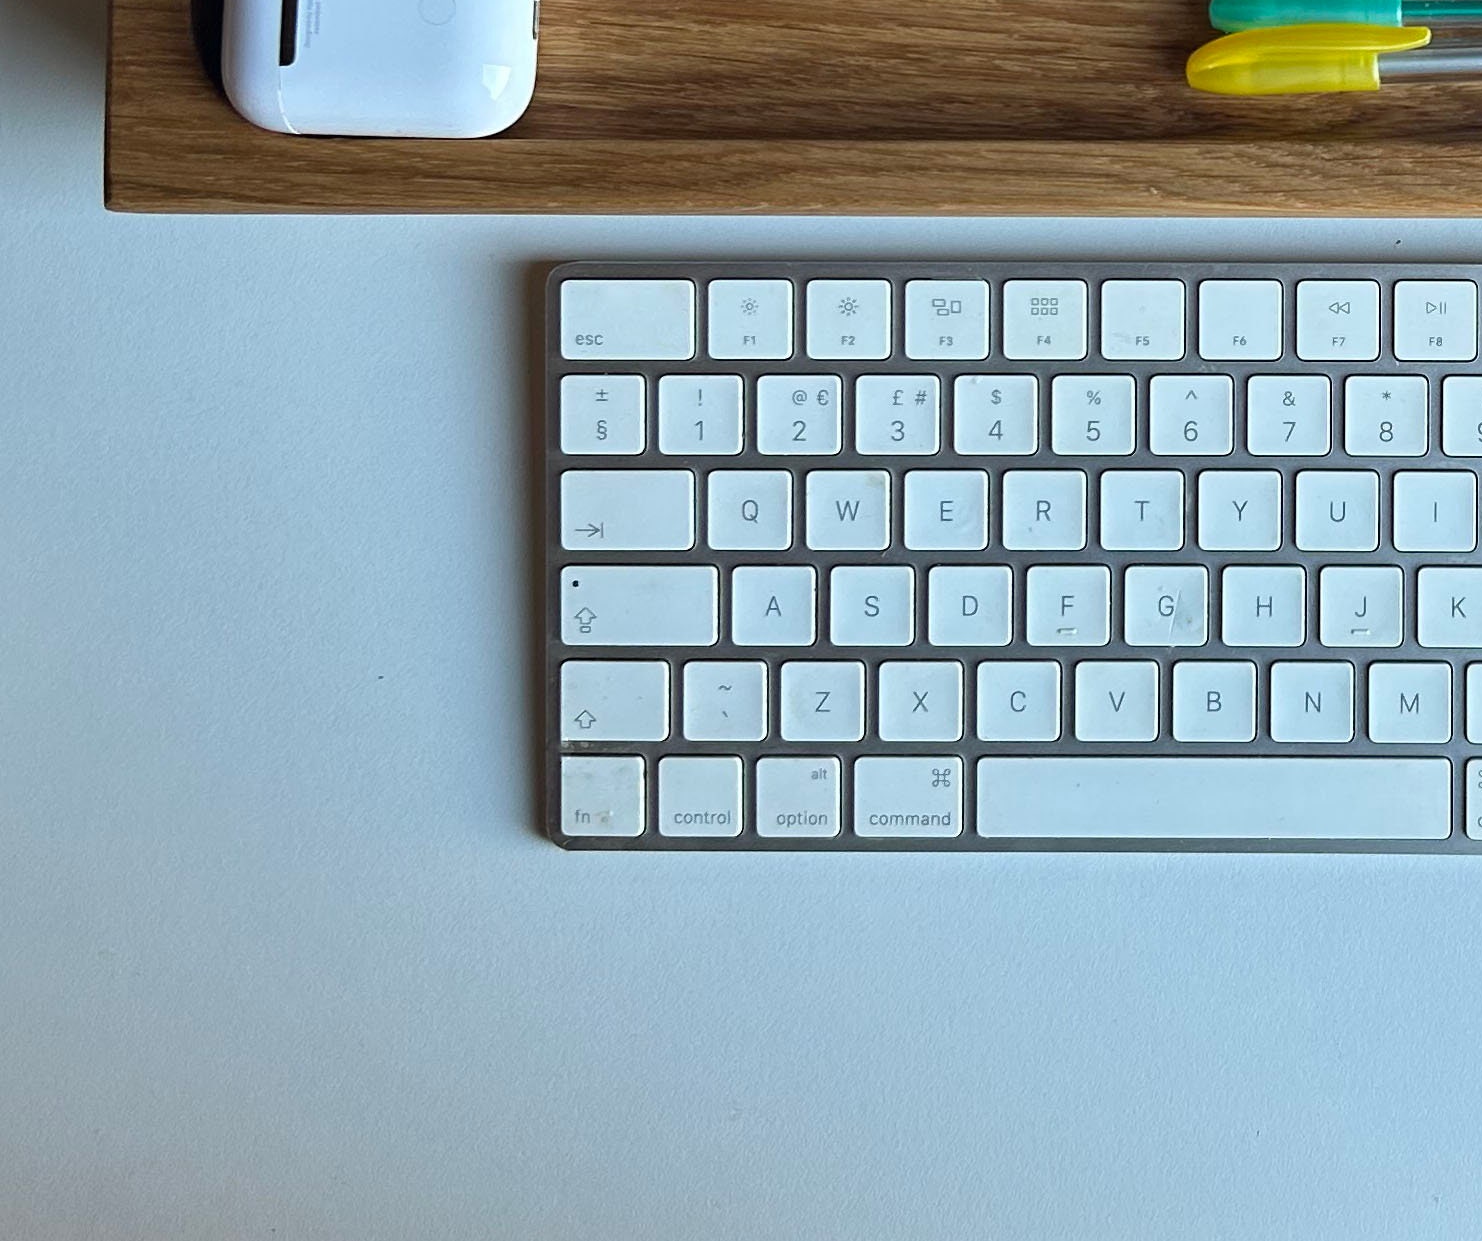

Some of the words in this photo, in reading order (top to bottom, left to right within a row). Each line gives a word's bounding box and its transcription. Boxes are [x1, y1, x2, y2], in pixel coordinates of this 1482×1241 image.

[574, 334, 604, 346] esc
[742, 335, 756, 345] F1
[840, 335, 856, 346] F2
[939, 335, 954, 347] F3
[1036, 335, 1052, 345] F4
[1135, 335, 1150, 347] F5
[1232, 335, 1248, 346] F6
[1332, 336, 1346, 347] F7
[1428, 336, 1443, 347] F8
[595, 389, 609, 402] ±
[791, 389, 808, 406] @
[816, 389, 829, 406] €
[892, 389, 904, 406] £
[914, 390, 927, 405] #
[990, 388, 1002, 406] $
[1086, 390, 1102, 406] %
[1282, 390, 1296, 407] &
[596, 419, 608, 441] §
[694, 420, 704, 441] 1
[791, 420, 807, 442] 2
[890, 420, 905, 442] 3
[988, 419, 1004, 441] 4
[1086, 420, 1101, 442] 5
[1183, 420, 1199, 442] 6
[1282, 421, 1297, 442] 7
[1379, 421, 1394, 443] 8
[741, 499, 759, 524] Q
[835, 500, 860, 522] W
[939, 500, 954, 522] E
[1036, 499, 1052, 522] R
[1134, 500, 1150, 522] T
[1232, 500, 1249, 522] Y
[1329, 501, 1346, 523] U
[765, 595, 782, 617] A
[864, 595, 880, 618] S
[962, 595, 979, 617] D
[1061, 595, 1075, 617] F
[1158, 594, 1175, 617] G
[1256, 595, 1273, 618] H
[1354, 596, 1367, 618] J
[1451, 596, 1467, 618] K
[815, 691, 831, 713] Z
[912, 691, 929, 713] X
[1010, 690, 1027, 713] C
[1108, 691, 1126, 713] V
[1206, 690, 1222, 713] B
[1305, 691, 1322, 713] N
[1400, 692, 1420, 715] M
[810, 767, 828, 781] alt
[574, 809, 591, 824] fn
[673, 810, 731, 825] control
[776, 810, 828, 828] option
[869, 811, 951, 827] command
